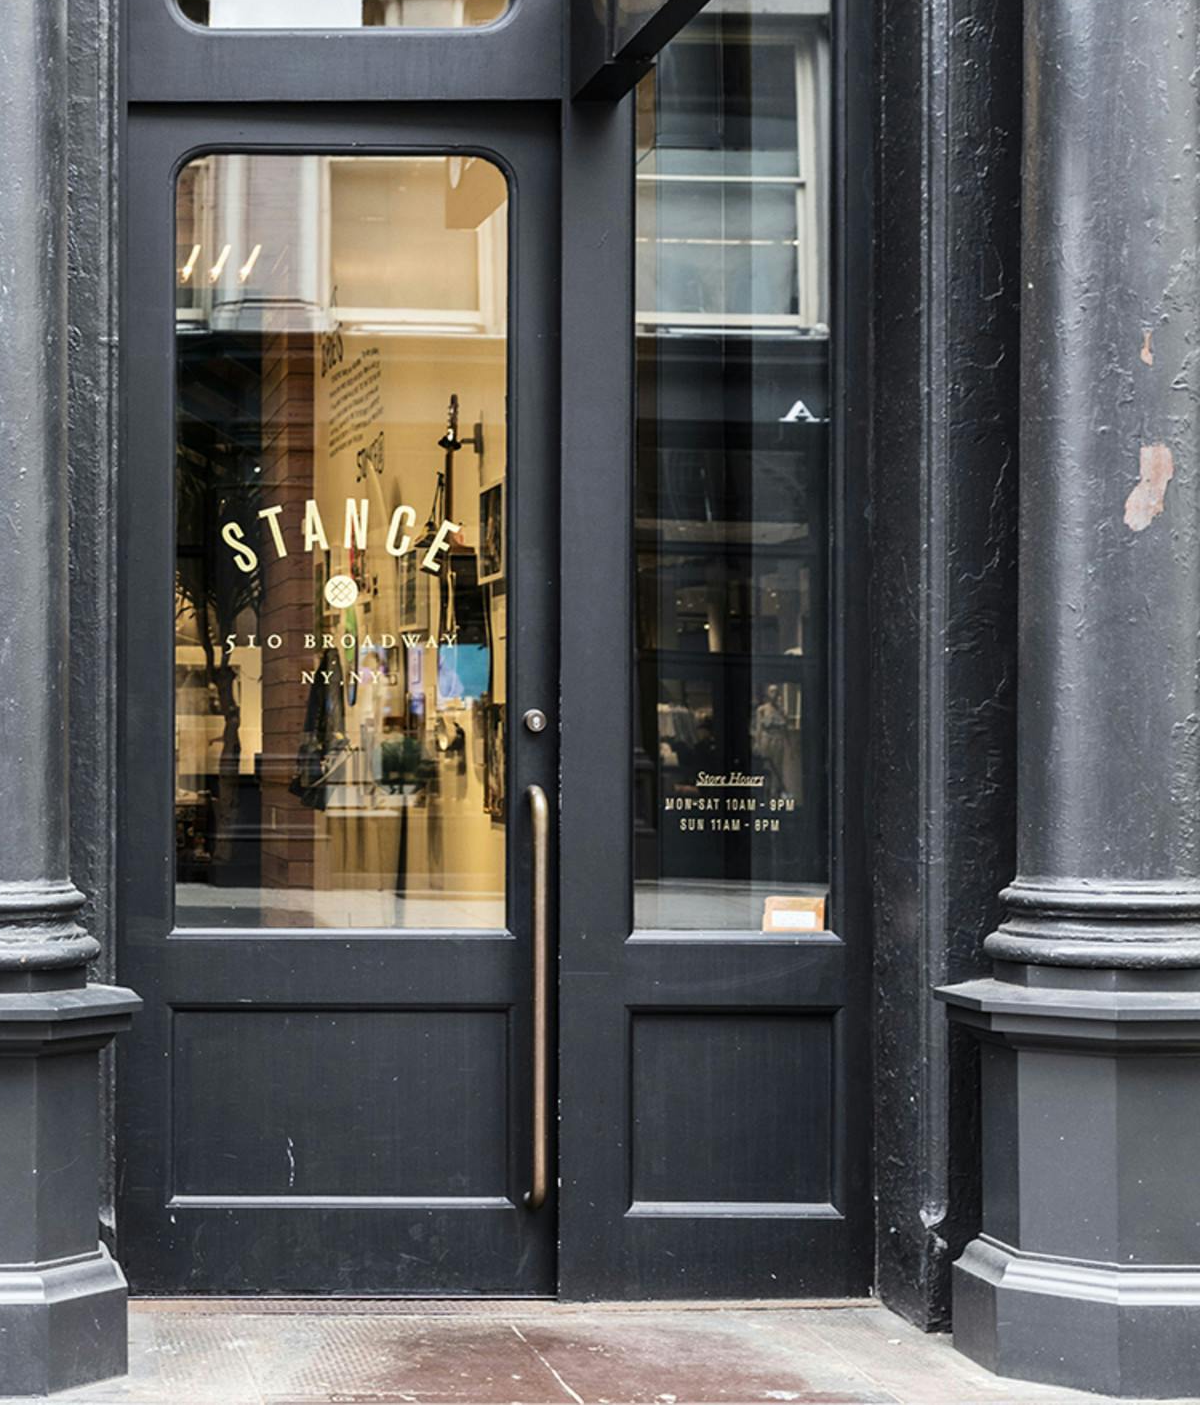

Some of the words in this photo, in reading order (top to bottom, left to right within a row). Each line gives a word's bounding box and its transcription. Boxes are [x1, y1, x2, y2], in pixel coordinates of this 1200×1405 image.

[221, 498, 461, 573] STANCE
[225, 633, 282, 654] 510
[304, 633, 457, 649] BROADWAY
[696, 771, 726, 786] Store
[729, 772, 765, 786] Hours
[664, 798, 720, 811] MON-SAT
[725, 798, 756, 811] 10AM
[769, 799, 795, 812] 9PM
[679, 818, 704, 831] SUN
[711, 818, 740, 831] 11AM
